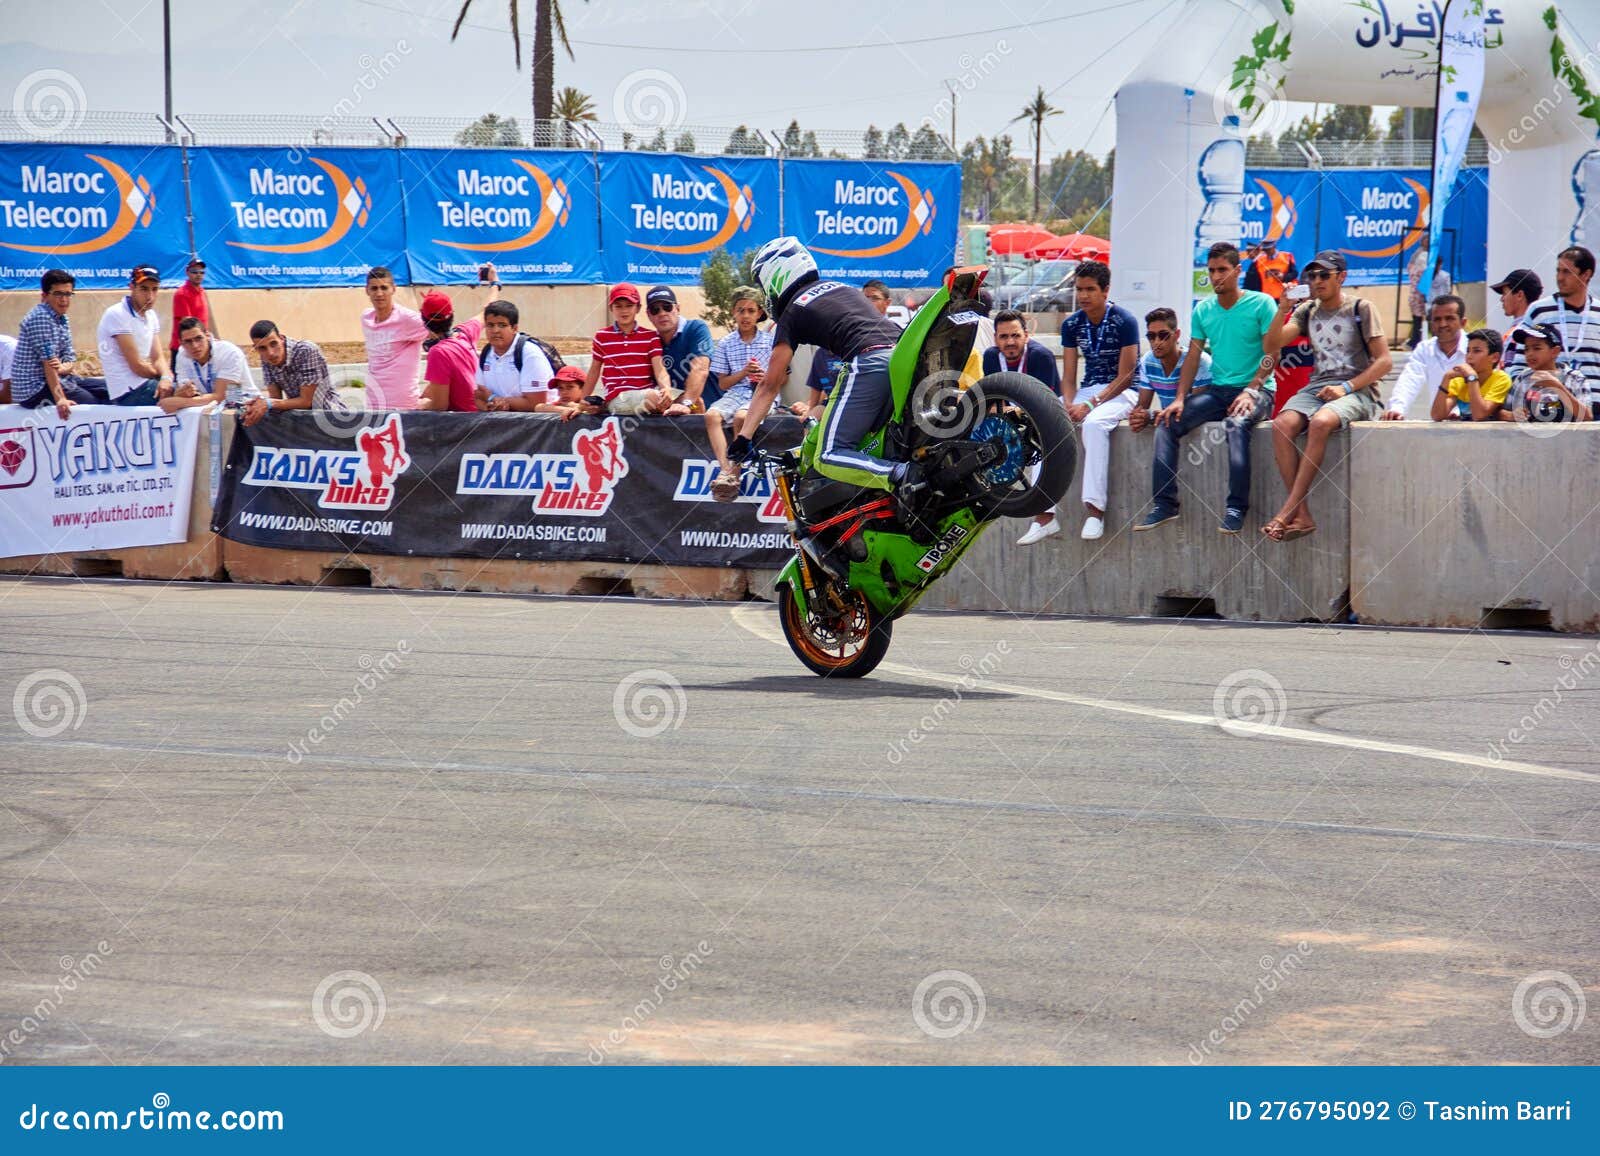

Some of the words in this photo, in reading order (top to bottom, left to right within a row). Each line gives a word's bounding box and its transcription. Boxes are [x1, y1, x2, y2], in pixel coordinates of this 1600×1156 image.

[22, 165, 105, 194] Maroc
[250, 168, 324, 196] Maroc
[457, 169, 529, 197] Maroc
[652, 173, 717, 201] Maroc
[834, 179, 899, 206] Maroc
[1241, 192, 1264, 211] roc
[1362, 187, 1413, 210] Maroc
[1, 200, 107, 229] Telecom
[230, 201, 328, 229] Telecom
[437, 201, 531, 228] Telecom
[631, 203, 718, 232] Telecom
[815, 210, 898, 236] Telecom
[1345, 215, 1408, 238] Telecom
[15, 266, 47, 278] mond
[97, 268, 119, 278] vous
[231, 265, 246, 277] Un
[248, 264, 281, 276] monde
[282, 266, 320, 276] nouveau
[321, 267, 341, 276] vous
[523, 264, 543, 273] vous
[544, 262, 573, 275] appelle
[640, 263, 668, 275] monde
[38, 414, 181, 482] YAKUT
[252, 452, 362, 486] DADA'S
[463, 459, 578, 490] DADA'S
[325, 477, 390, 505] bike
[538, 481, 608, 510] bike
[239, 511, 393, 536] WWW.DADASBIKE.COM
[461, 523, 607, 543] WWW.DADASBIKE.COM
[681, 530, 797, 550] WWW.DADASBIK
[925, 524, 967, 563] IPONE
